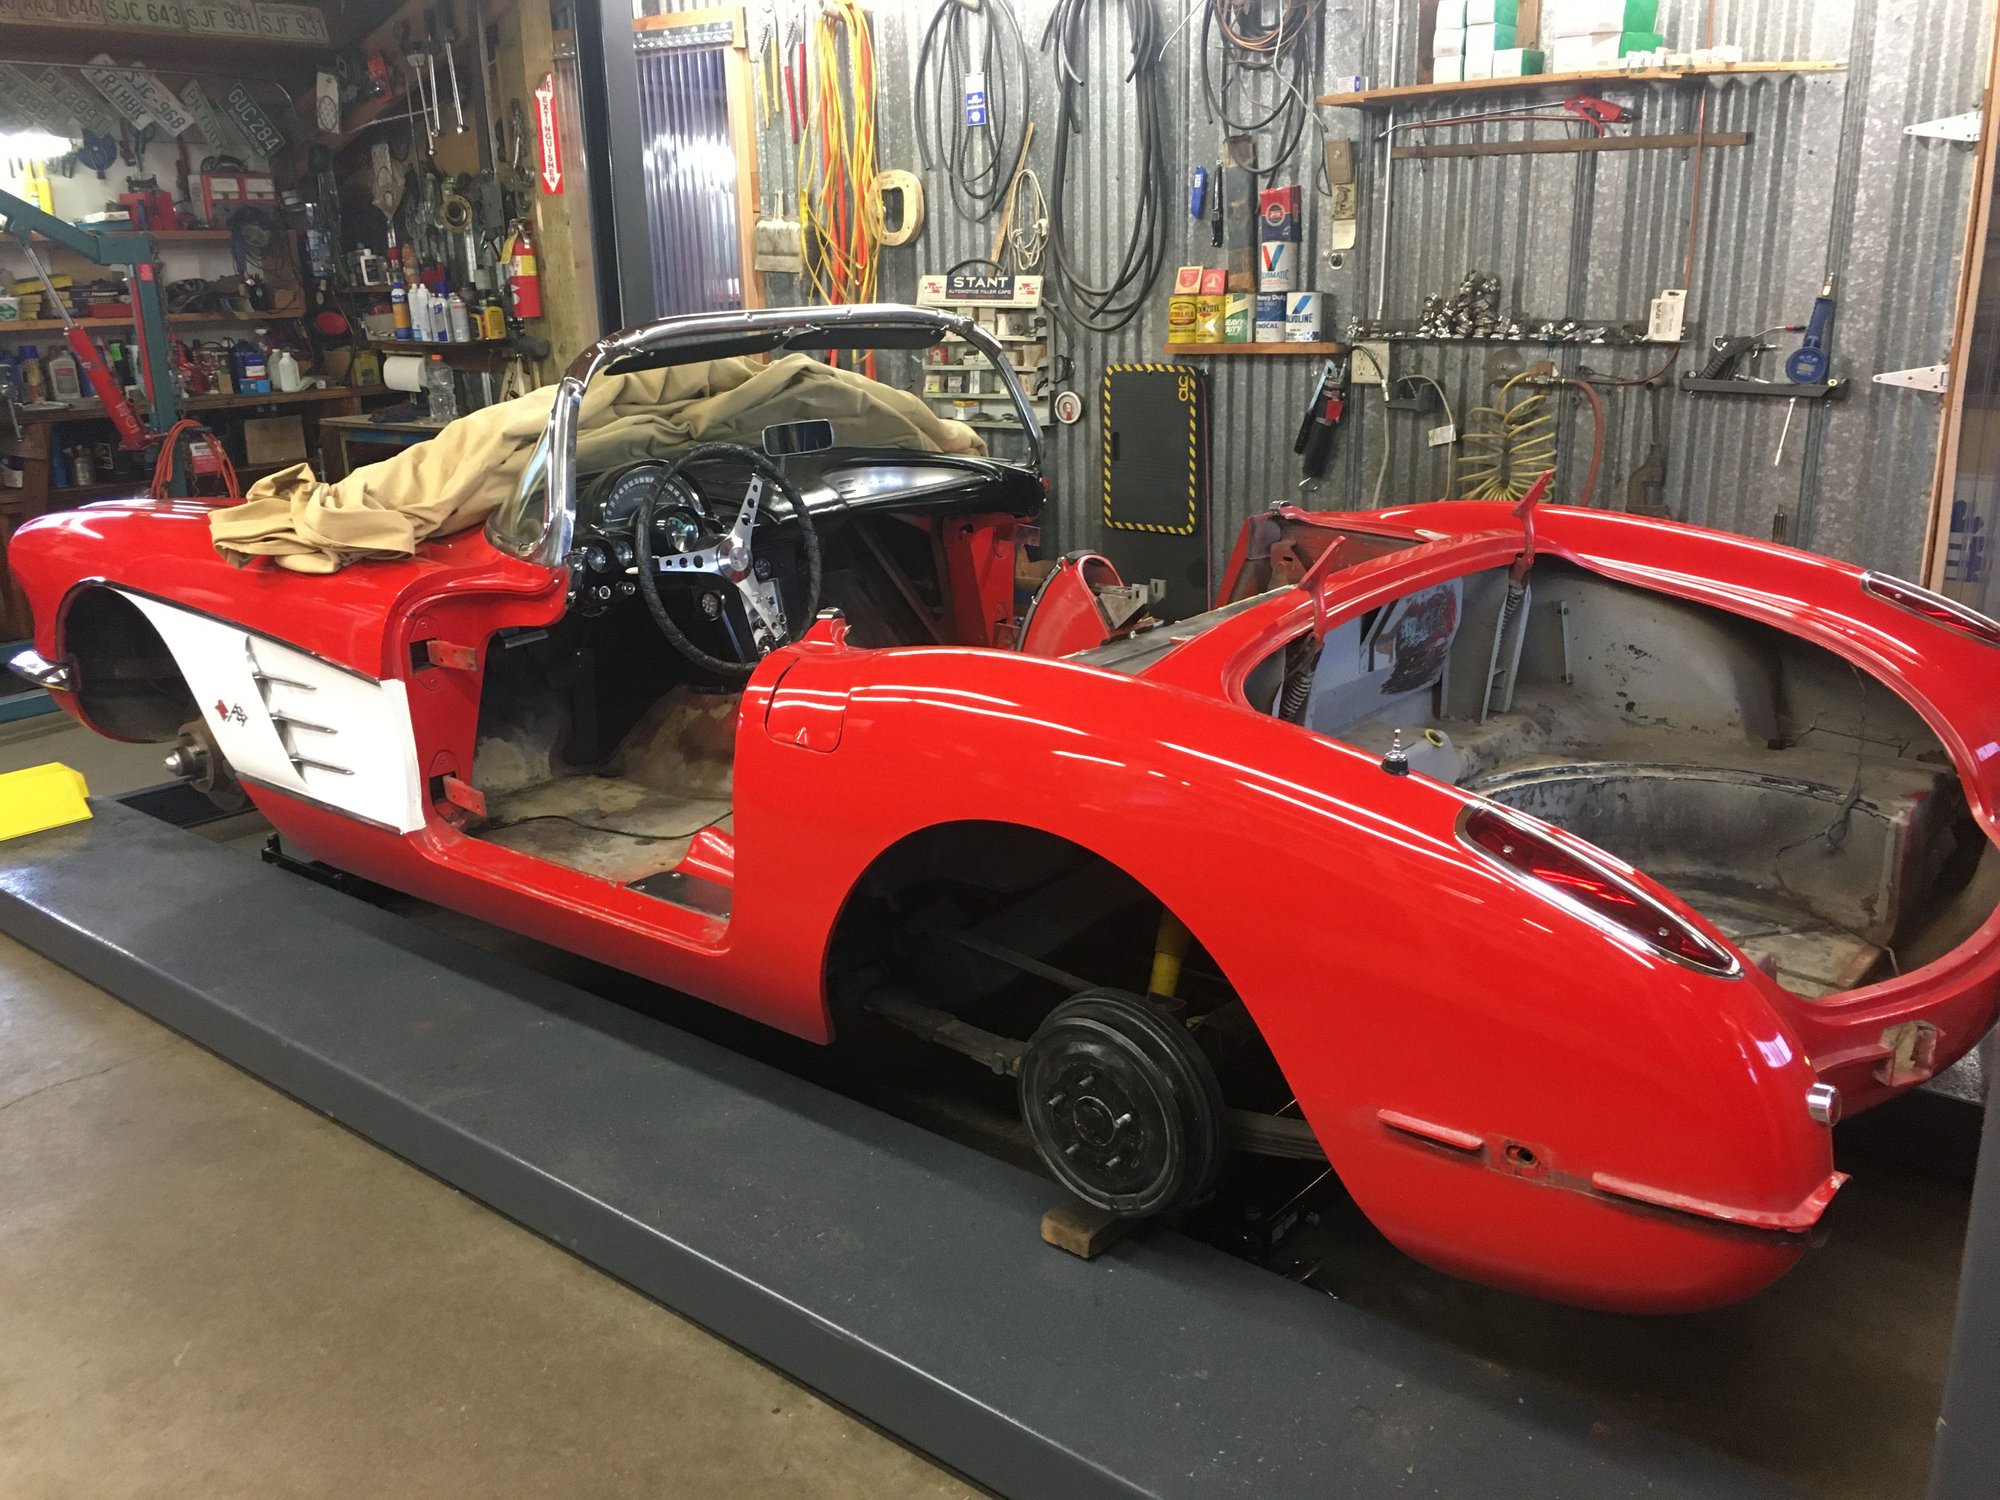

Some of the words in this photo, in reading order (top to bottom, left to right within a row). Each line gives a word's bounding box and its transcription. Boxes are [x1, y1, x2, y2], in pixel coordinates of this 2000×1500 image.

[106, 1, 142, 22] SJC
[147, 4, 181, 25] 643
[186, 9, 217, 28] SJF
[224, 11, 256, 32] 931
[260, 15, 290, 34] SJF
[296, 17, 327, 37] 931
[228, 89, 258, 121] GUC
[249, 118, 280, 151] 284
[542, 96, 556, 184] EXTINGUISHER
[953, 276, 1009, 288] STANT
